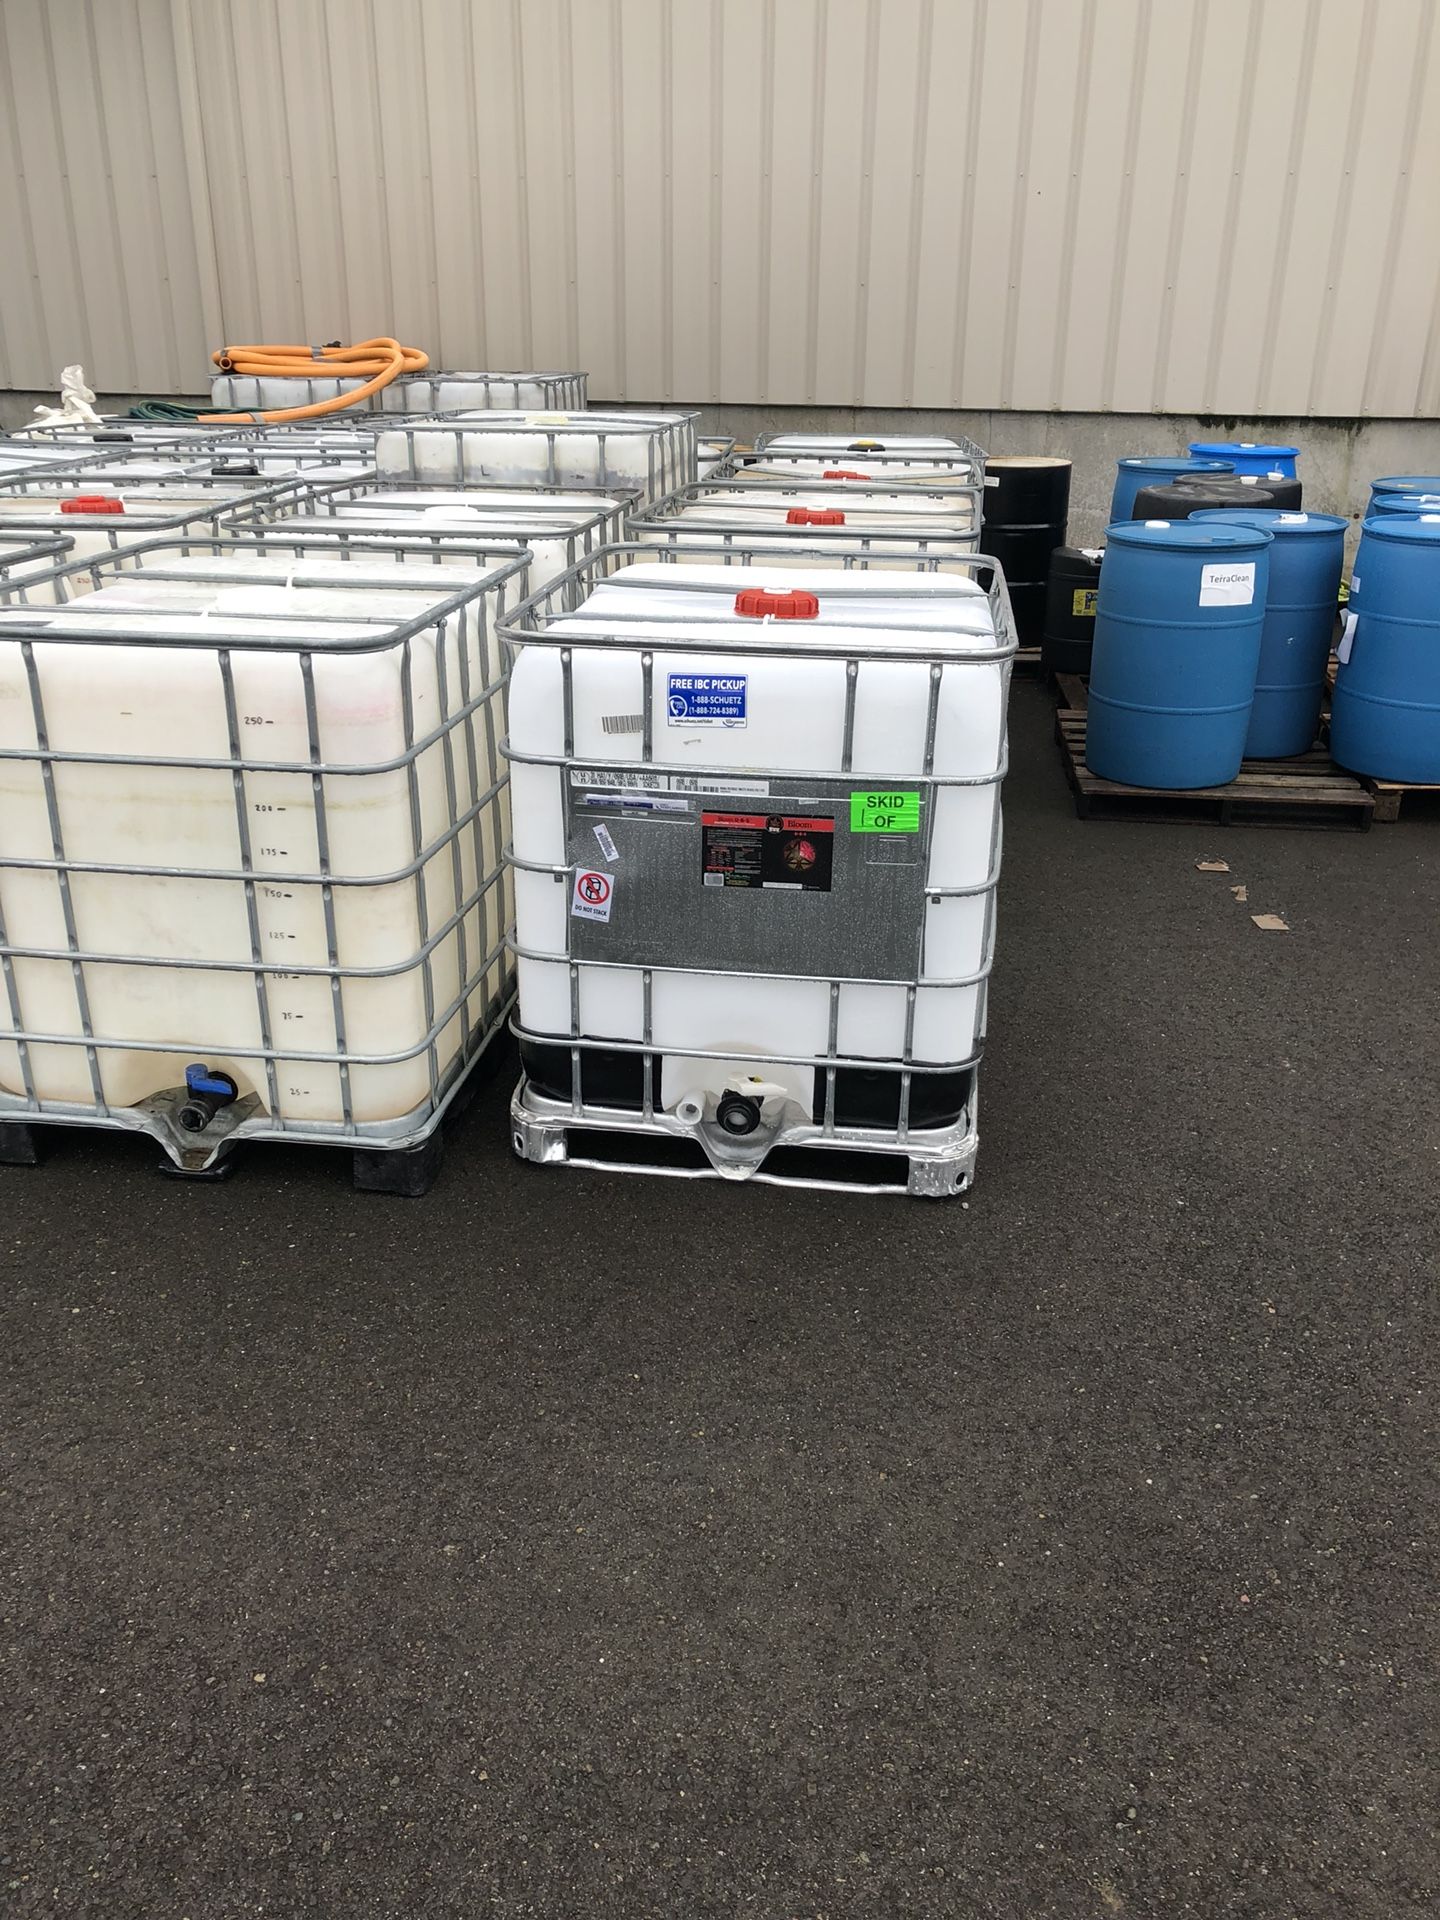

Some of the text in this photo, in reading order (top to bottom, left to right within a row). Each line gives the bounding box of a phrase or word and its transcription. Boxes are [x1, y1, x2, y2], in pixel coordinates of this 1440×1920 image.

[1209, 575, 1250, 584] TerraClean
[671, 679, 746, 690] FREE IBC PICKUP
[691, 696, 742, 705] 1-888-SCHUETZ
[244, 716, 263, 725] 250
[867, 796, 904, 808] SKID
[254, 804, 272, 812] 200
[788, 820, 813, 829] Bloom
[874, 815, 896, 828] OF
[260, 847, 277, 856] 175
[593, 909, 607, 917] STACK
[269, 931, 284, 939] 125
[290, 1088, 301, 1096] 25
